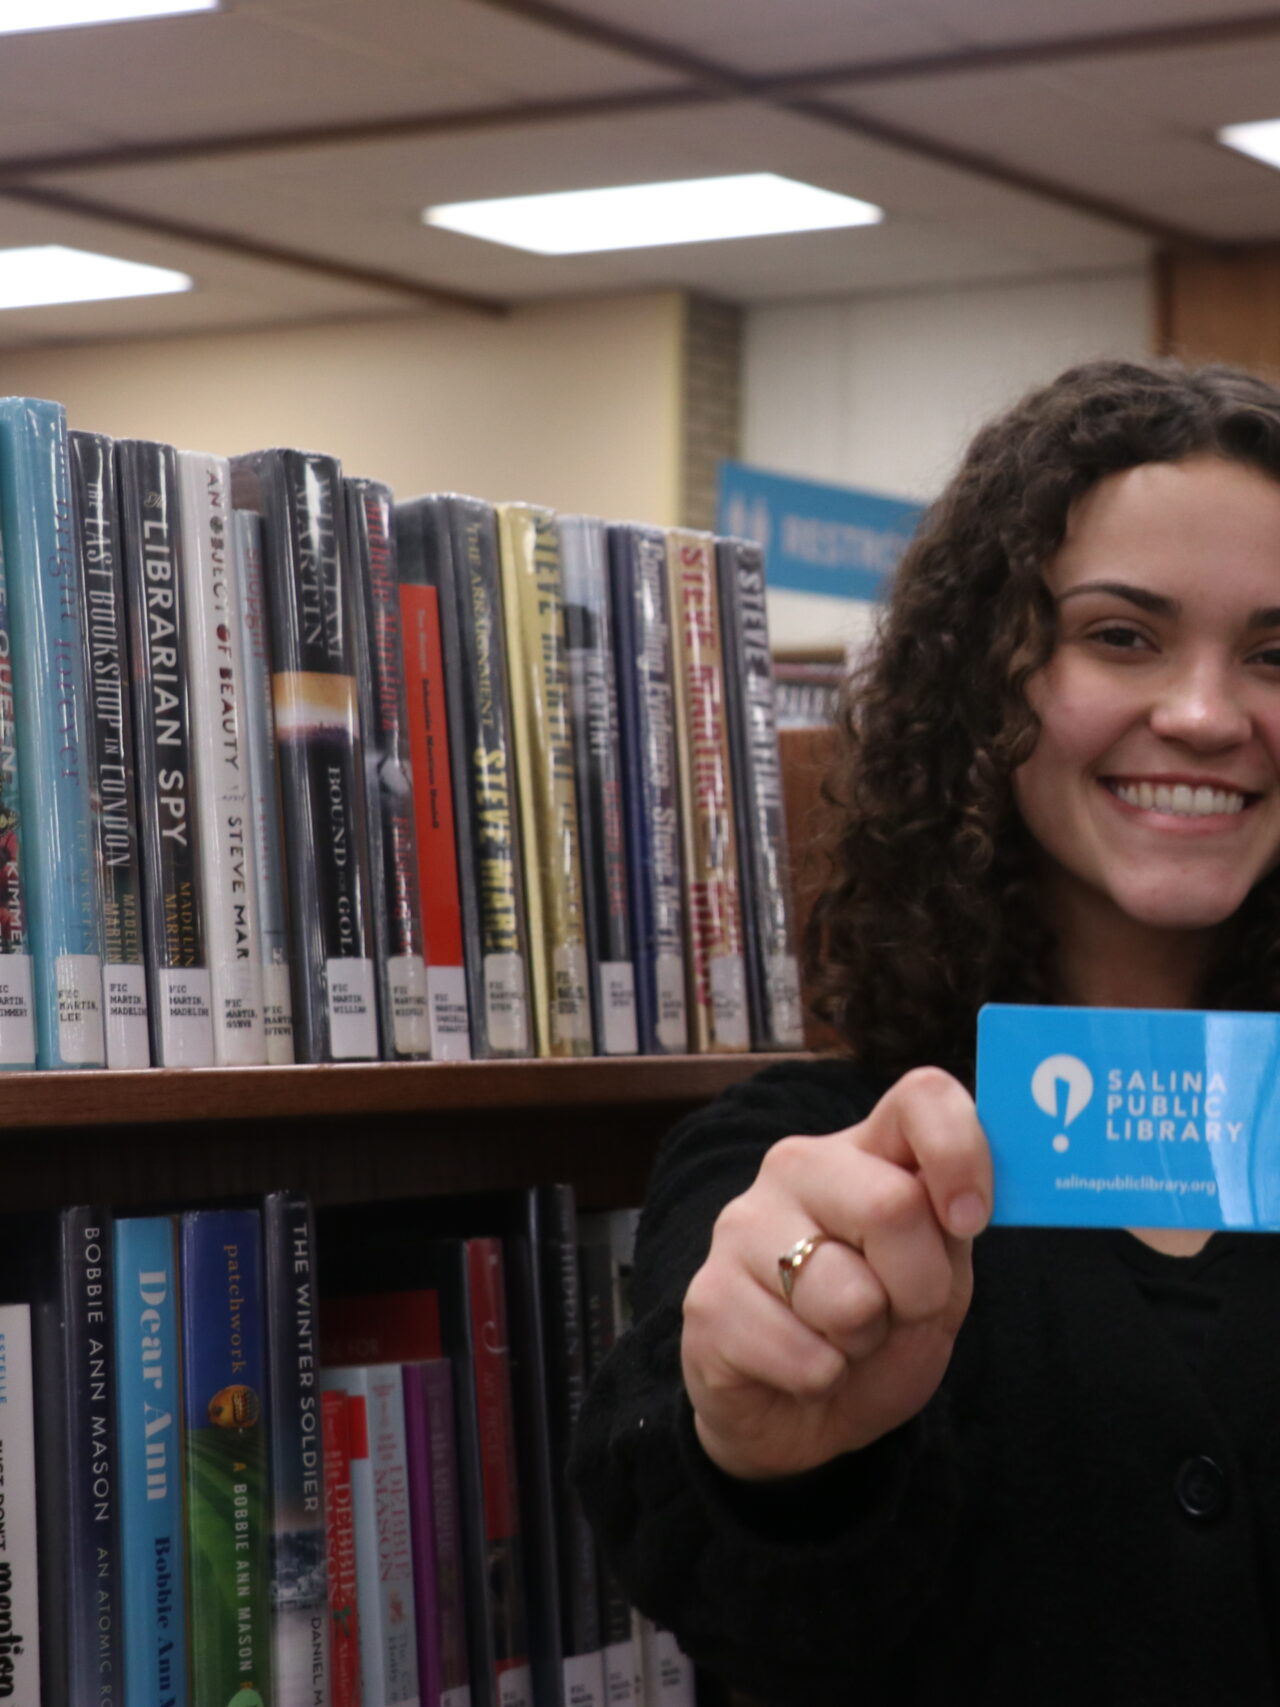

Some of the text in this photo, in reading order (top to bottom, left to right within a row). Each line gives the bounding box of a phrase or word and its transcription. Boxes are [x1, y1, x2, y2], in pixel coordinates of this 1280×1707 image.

[296, 482, 325, 647] MARTIN
[317, 477, 345, 657] WILLIAM
[466, 521, 482, 566] THE
[143, 519, 182, 746] LIBRARIAN
[206, 469, 240, 771] AN OBJECT OF BEAUTY
[680, 546, 716, 649] STEVE
[736, 569, 768, 664] STEVE
[83, 482, 131, 868] THE LAST BOOKSHOP IN LONDON
[647, 682, 674, 788] Evidence
[158, 768, 188, 847] SPY
[473, 747, 512, 845] STEVE
[228, 815, 250, 960] STEVE MAR
[326, 765, 348, 867] BOUND
[337, 896, 353, 957] GOL
[59, 1012, 83, 1023] LEE
[109, 984, 129, 993] FIC
[168, 984, 188, 994] FIC
[1106, 1094, 1223, 1119] PUBLIC
[1107, 1068, 1227, 1095] SALINA
[1105, 1118, 1243, 1143] LIBRARY
[1055, 1174, 1217, 1196] salinapubliclibrary.org
[223, 1243, 248, 1375] patchwork
[84, 1226, 110, 1522] BOBBIE ANN MASON
[138, 1269, 173, 1502] Dear Ann
[292, 1223, 319, 1512] THE WINTER SOLDIER
[232, 1461, 248, 1472] A
[97, 1547, 110, 1578] AN
[233, 1483, 250, 1551] BOBBIE
[334, 1482, 357, 1604] DEBBIE
[373, 1466, 393, 1583] MASON
[388, 1464, 411, 1582] DEBBIE
[154, 1535, 173, 1631] Bobbie
[235, 1560, 251, 1598] ANN
[98, 1589, 113, 1674] ATOMIC
[157, 1636, 176, 1692] Ann
[237, 1606, 254, 1672] MASON
[309, 1615, 325, 1686] DANIEL
